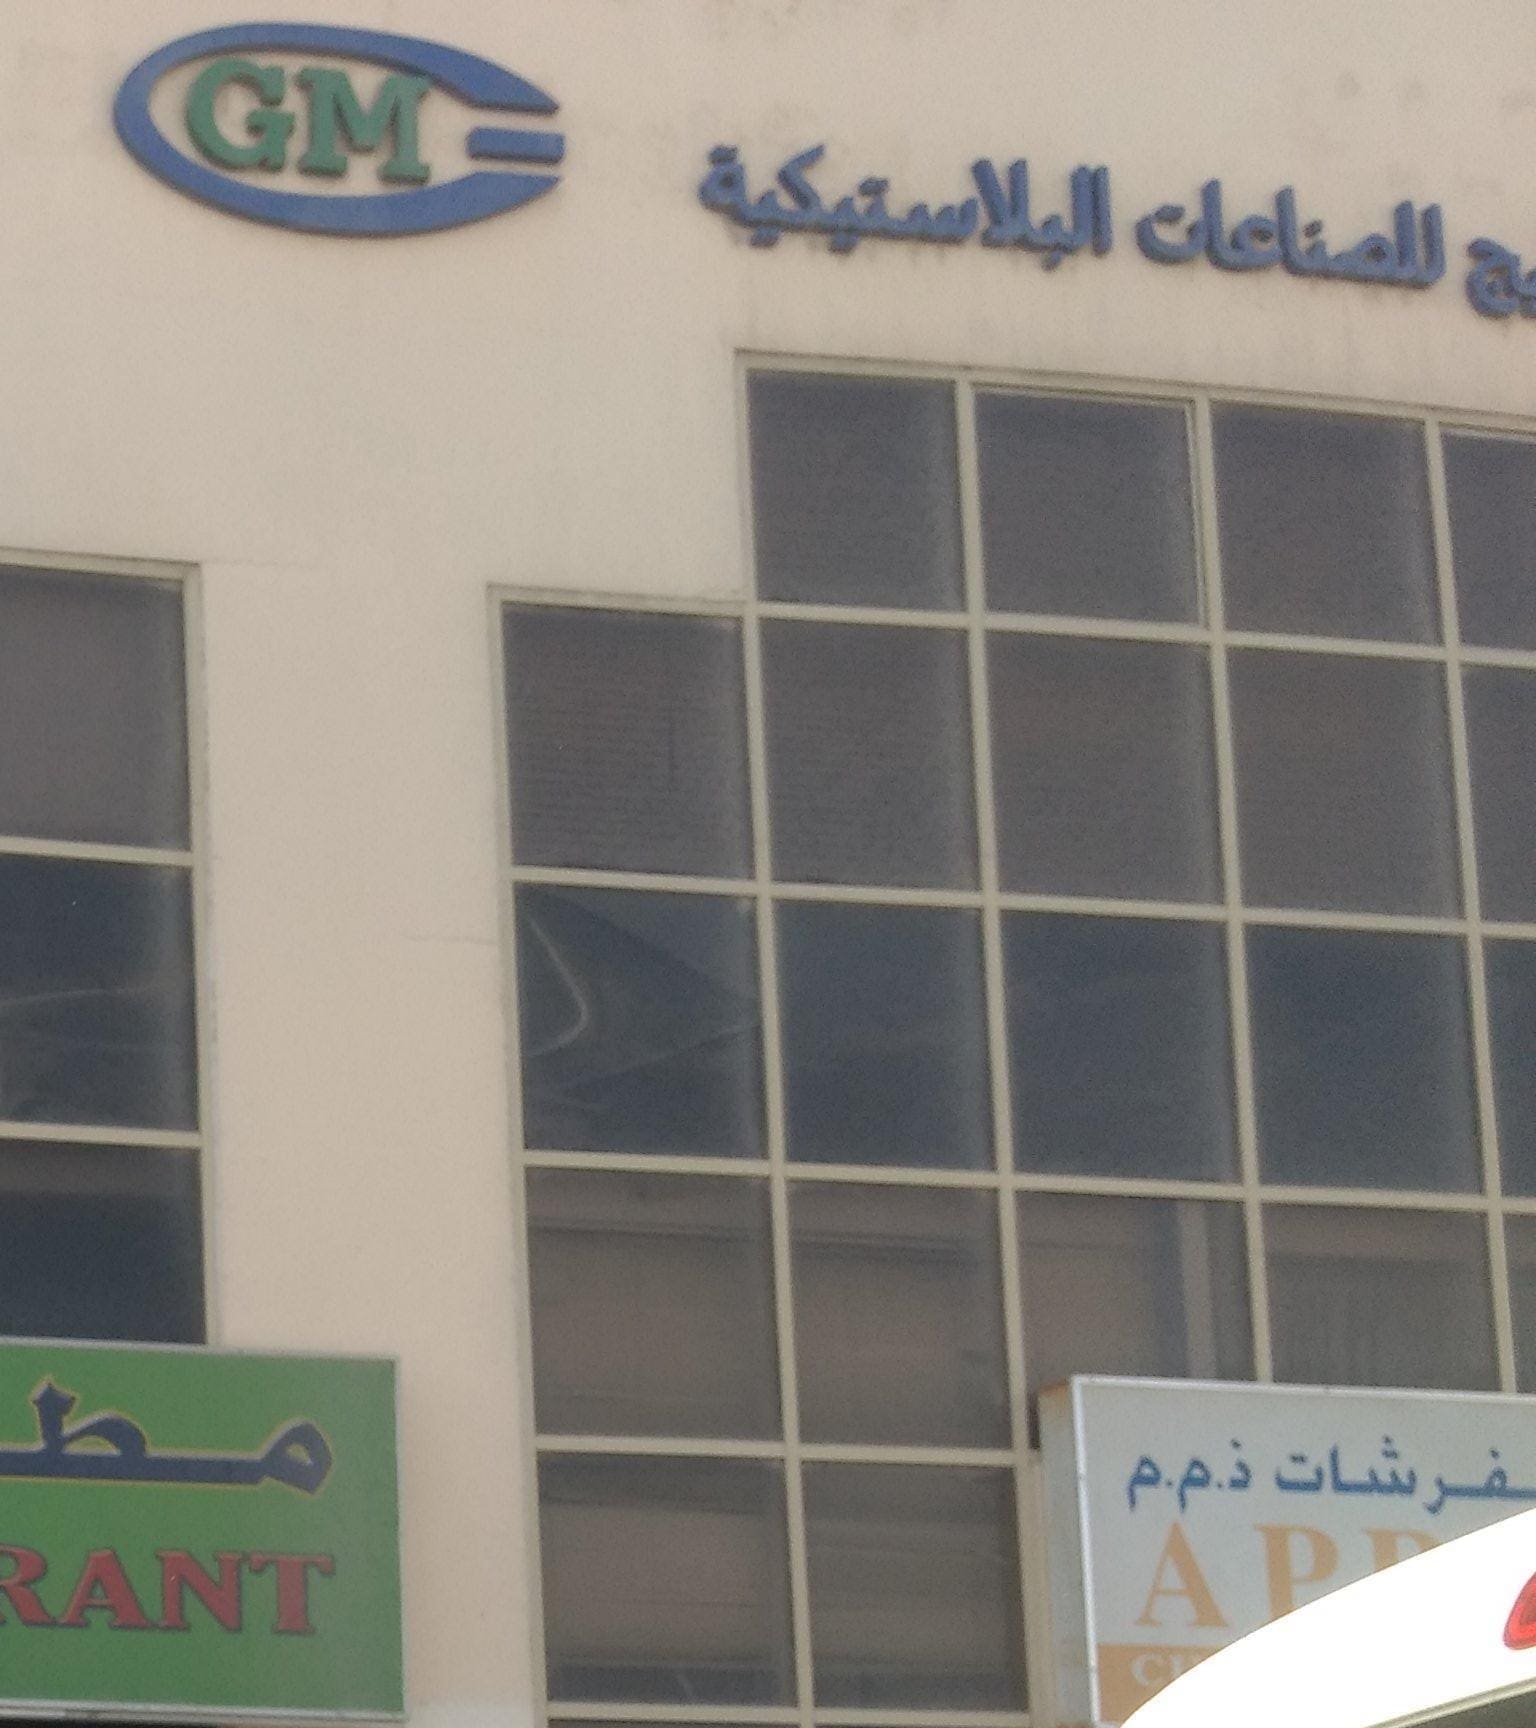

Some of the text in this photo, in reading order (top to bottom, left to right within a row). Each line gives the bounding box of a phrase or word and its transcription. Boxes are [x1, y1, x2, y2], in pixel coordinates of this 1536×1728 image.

[184, 55, 434, 186] GM
[696, 143, 1114, 273] البلاستيكية
[1133, 182, 1446, 290] للصناعات
